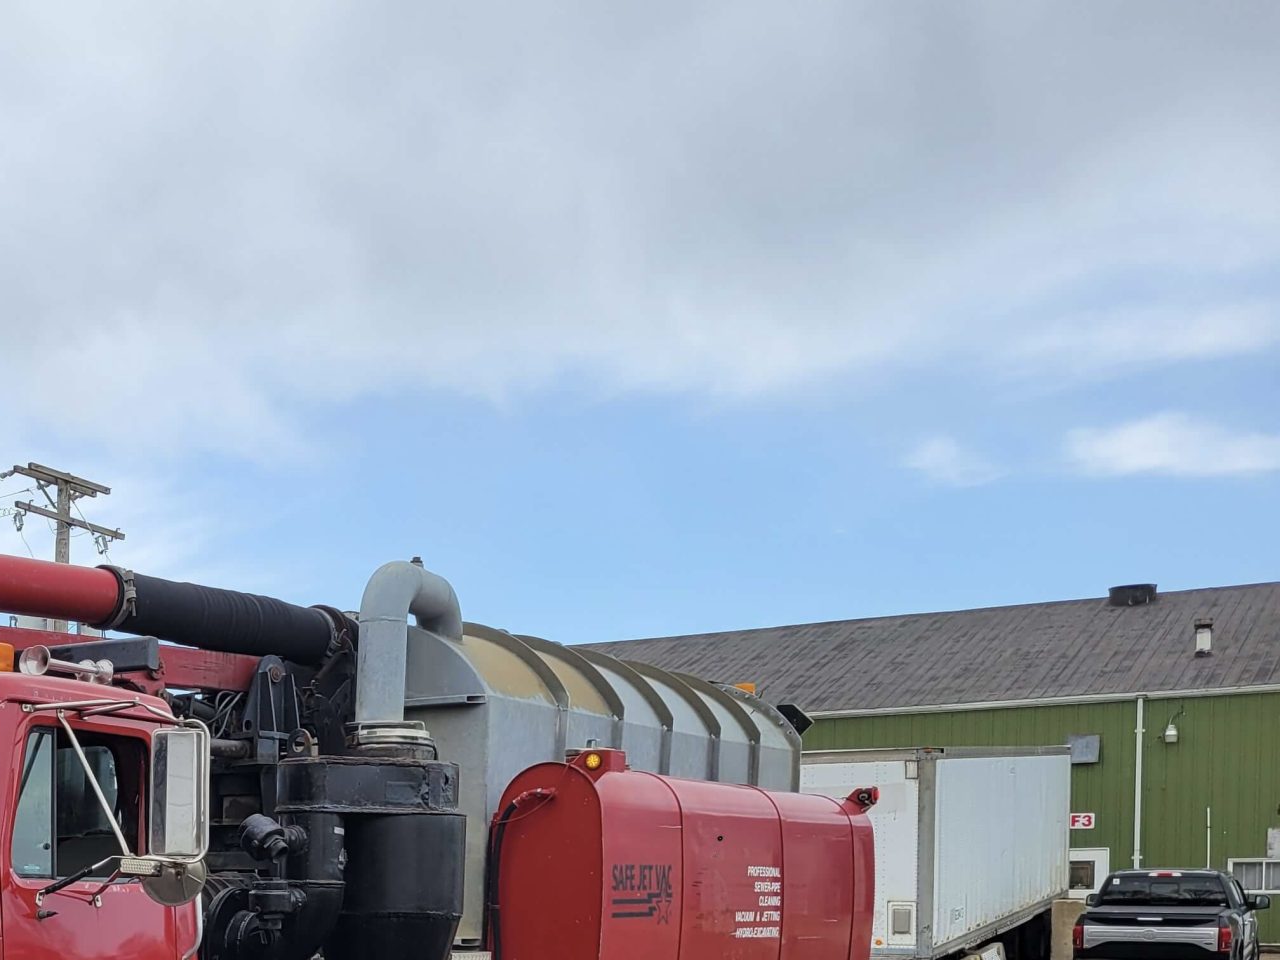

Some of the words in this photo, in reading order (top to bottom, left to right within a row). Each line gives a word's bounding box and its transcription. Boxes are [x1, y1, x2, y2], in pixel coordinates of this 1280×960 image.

[1071, 815, 1092, 827] F3
[747, 866, 781, 877] PROFESSIONAL
[611, 864, 635, 891] SAFE
[637, 864, 653, 891] JET
[655, 864, 672, 892] VAC
[754, 882, 781, 892] SEWER-PIPE
[759, 896, 781, 906] CLEANING
[735, 911, 754, 922] VACUUM
[762, 911, 780, 921] JETTING
